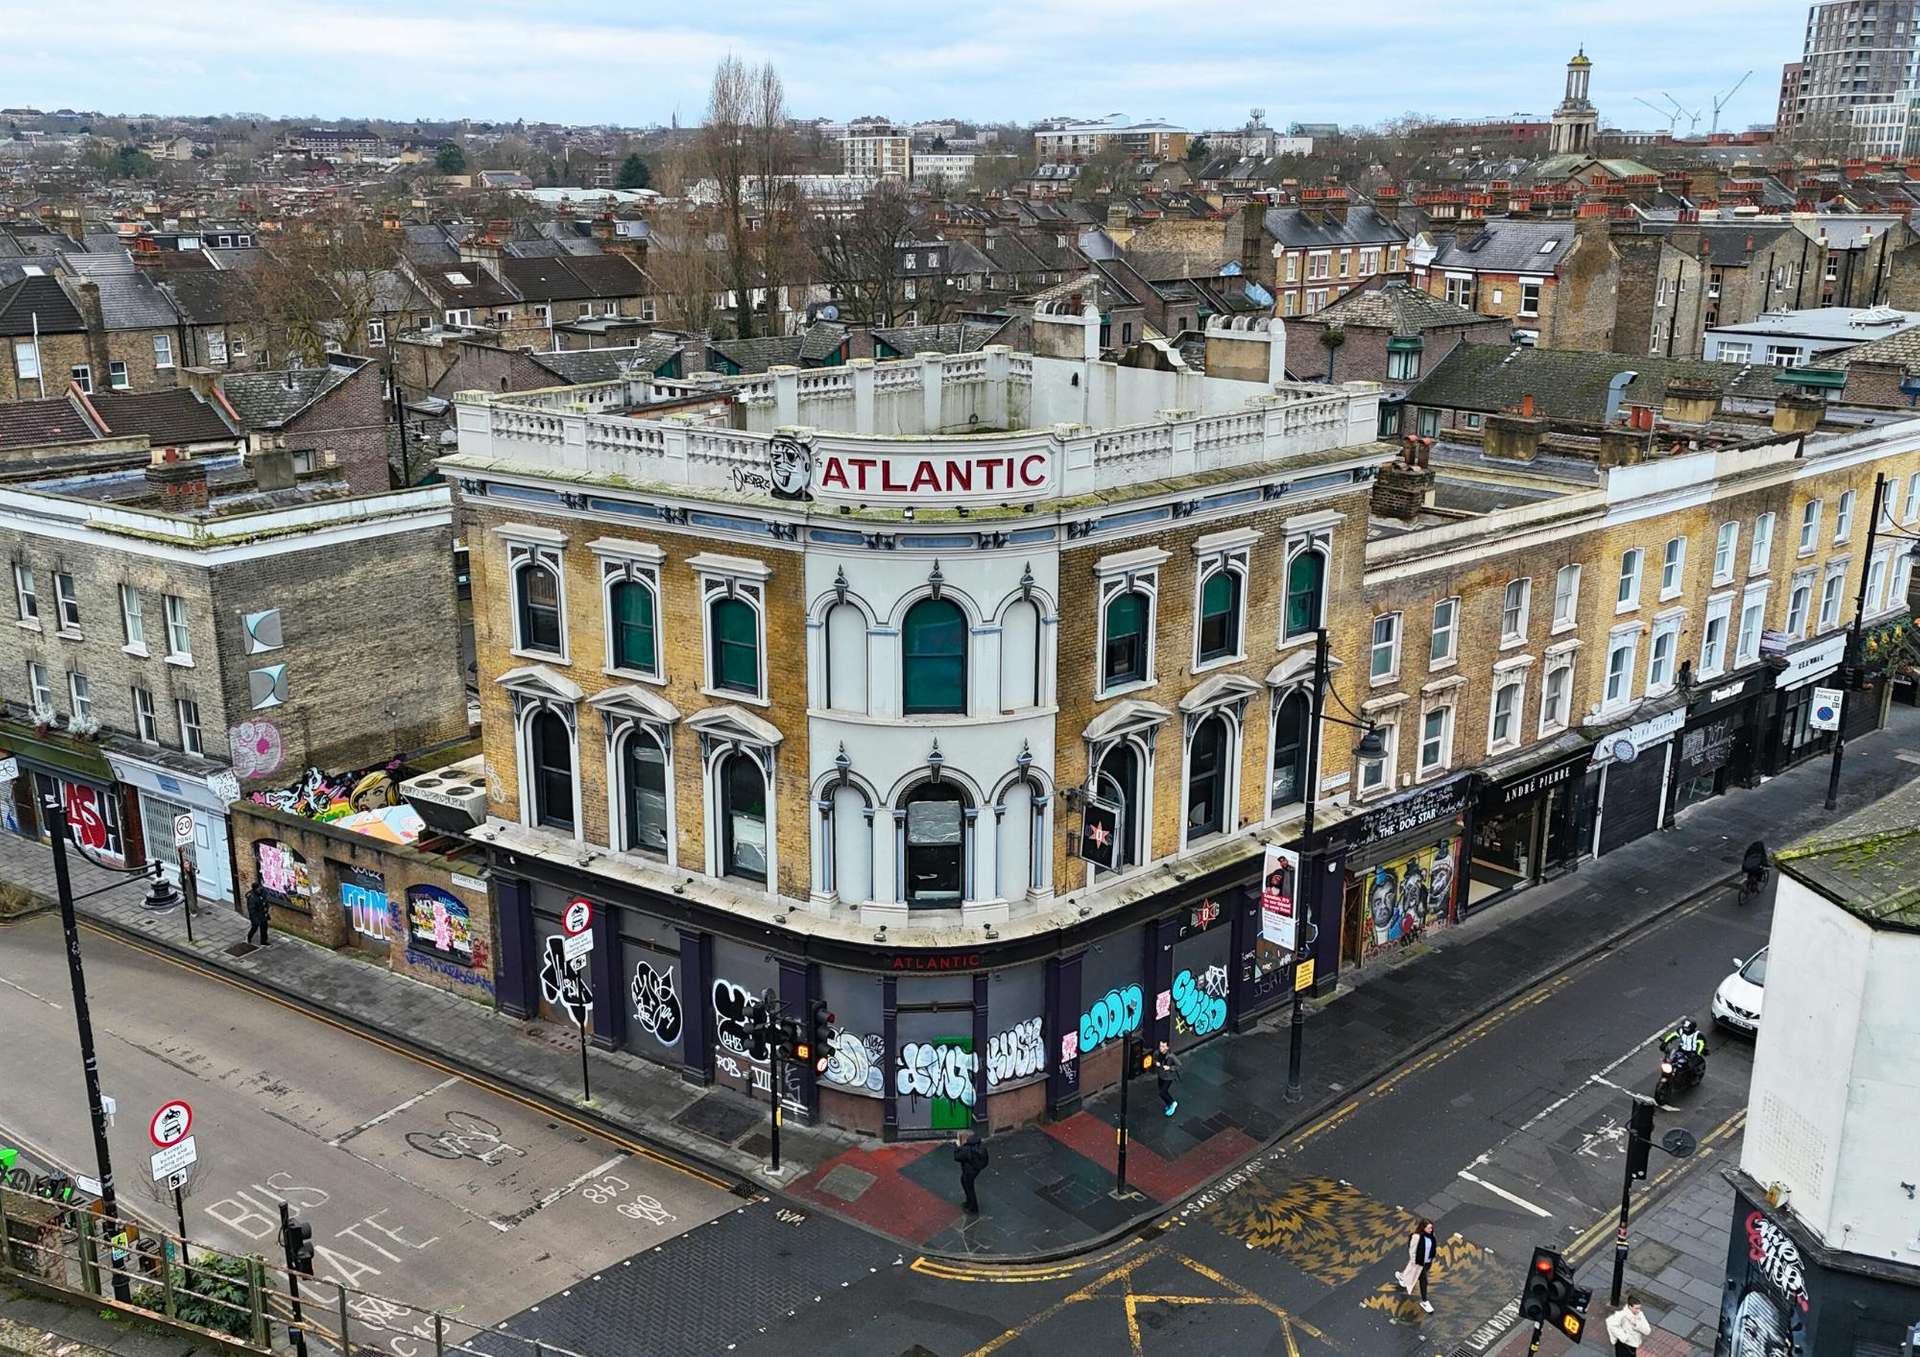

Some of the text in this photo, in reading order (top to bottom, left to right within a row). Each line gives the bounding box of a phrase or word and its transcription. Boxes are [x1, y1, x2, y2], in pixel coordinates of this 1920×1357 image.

[821, 454, 1046, 492] ATLANTIC
[1539, 766, 1571, 788] PIERRE
[178, 819, 191, 831] 20
[1379, 808, 1436, 839] THE DOG STAR
[894, 955, 979, 969] ATLANTIC
[204, 1171, 330, 1240] BUS
[1464, 1323, 1498, 1350] LOOK
